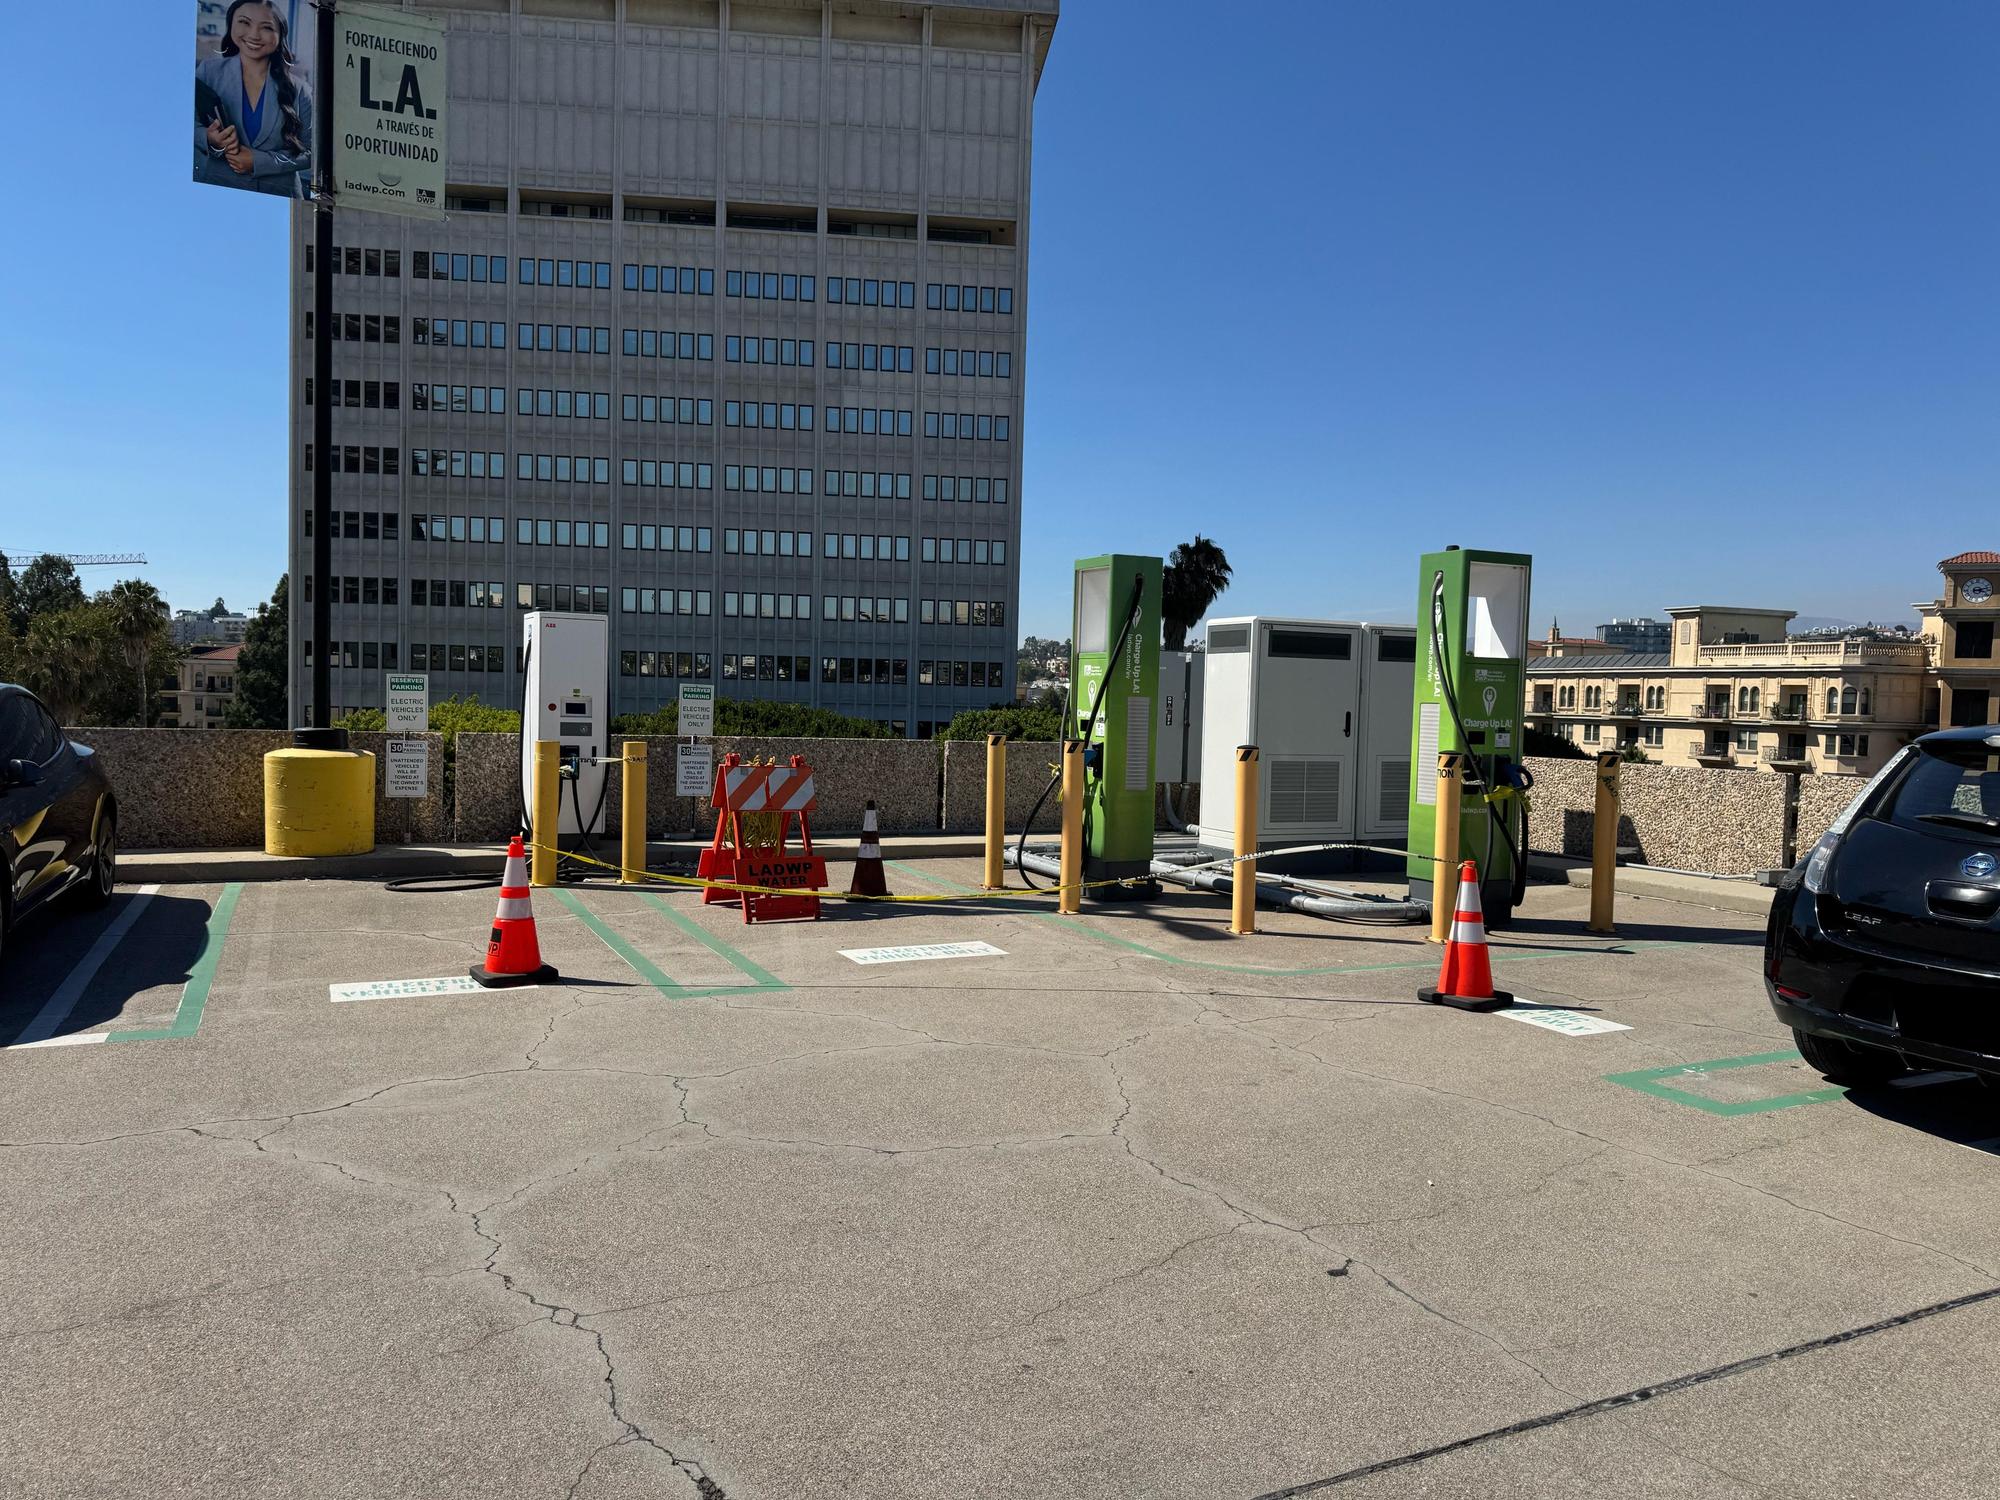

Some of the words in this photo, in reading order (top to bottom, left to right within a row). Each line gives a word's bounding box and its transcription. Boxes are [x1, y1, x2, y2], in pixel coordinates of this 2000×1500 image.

[345, 30, 438, 61] FORTALECIENDO
[346, 53, 355, 69] A
[360, 56, 437, 120] L.A.
[376, 119, 384, 131] A
[385, 118, 420, 137] TRAVÉS
[422, 126, 434, 139] DE
[345, 134, 439, 164] OPORTUNIDAD
[345, 180, 406, 198] ladwp.com
[416, 196, 435, 204] DWP
[1464, 719, 1488, 728] Charge
[1490, 720, 1500, 729] Up
[392, 744, 402, 752] 30
[748, 862, 813, 876] LADWP
[758, 876, 808, 887] WATER
[1844, 911, 1882, 925] LEAF
